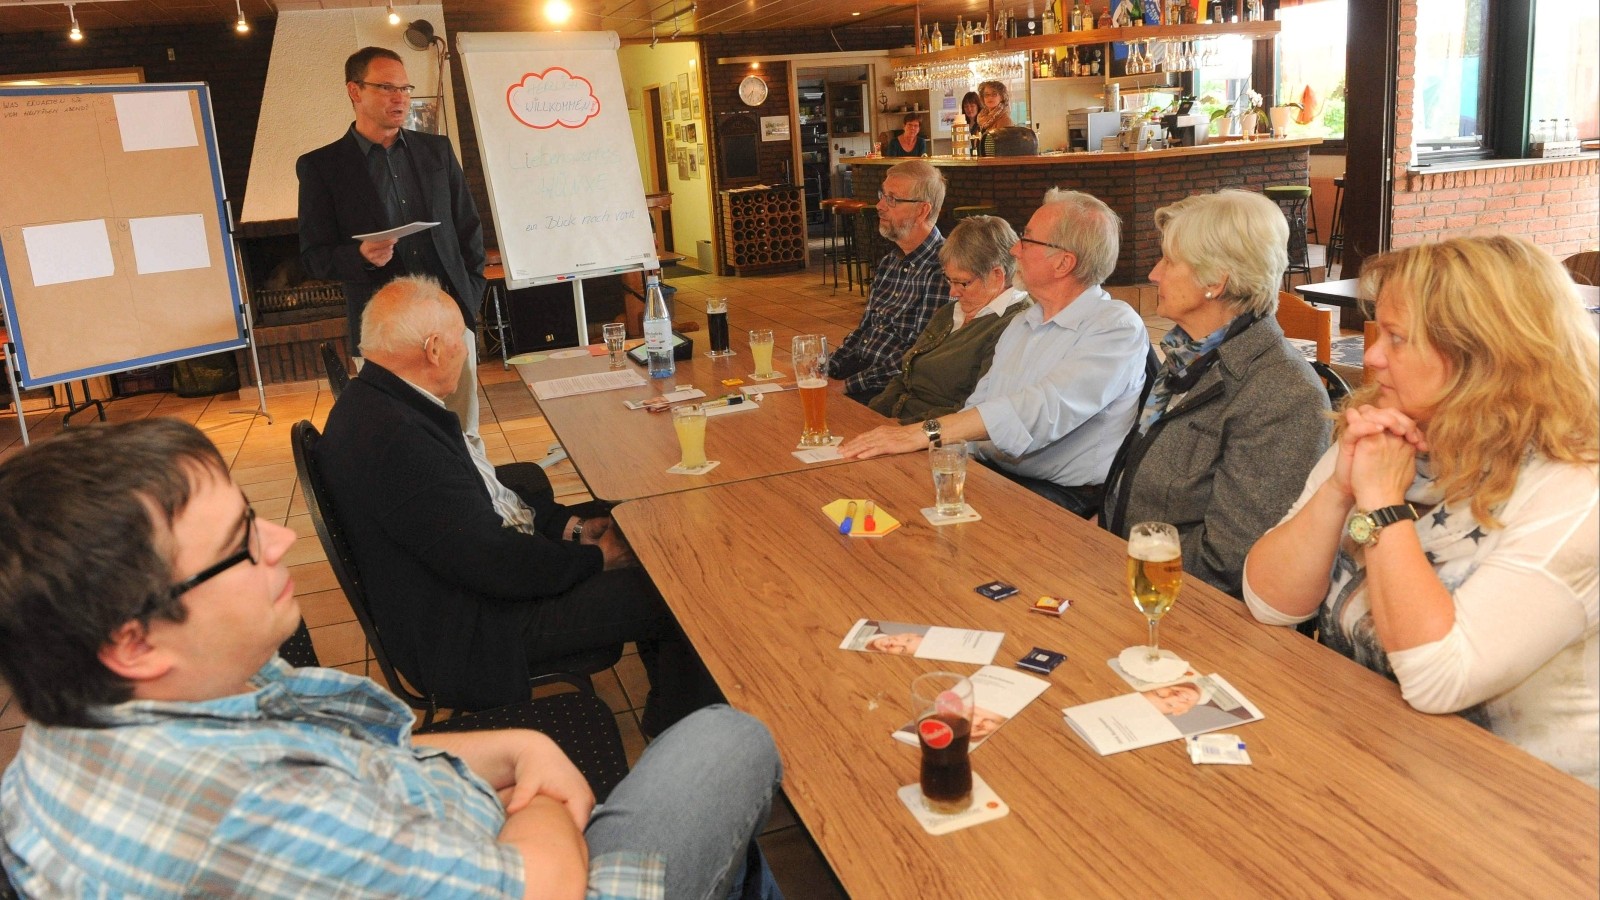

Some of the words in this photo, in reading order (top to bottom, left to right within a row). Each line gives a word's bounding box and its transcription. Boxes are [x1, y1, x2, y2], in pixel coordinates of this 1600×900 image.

[2, 100, 19, 109] WAS
[545, 214, 577, 230] Blick
[582, 209, 610, 225] nach
[615, 209, 635, 222] vorn
